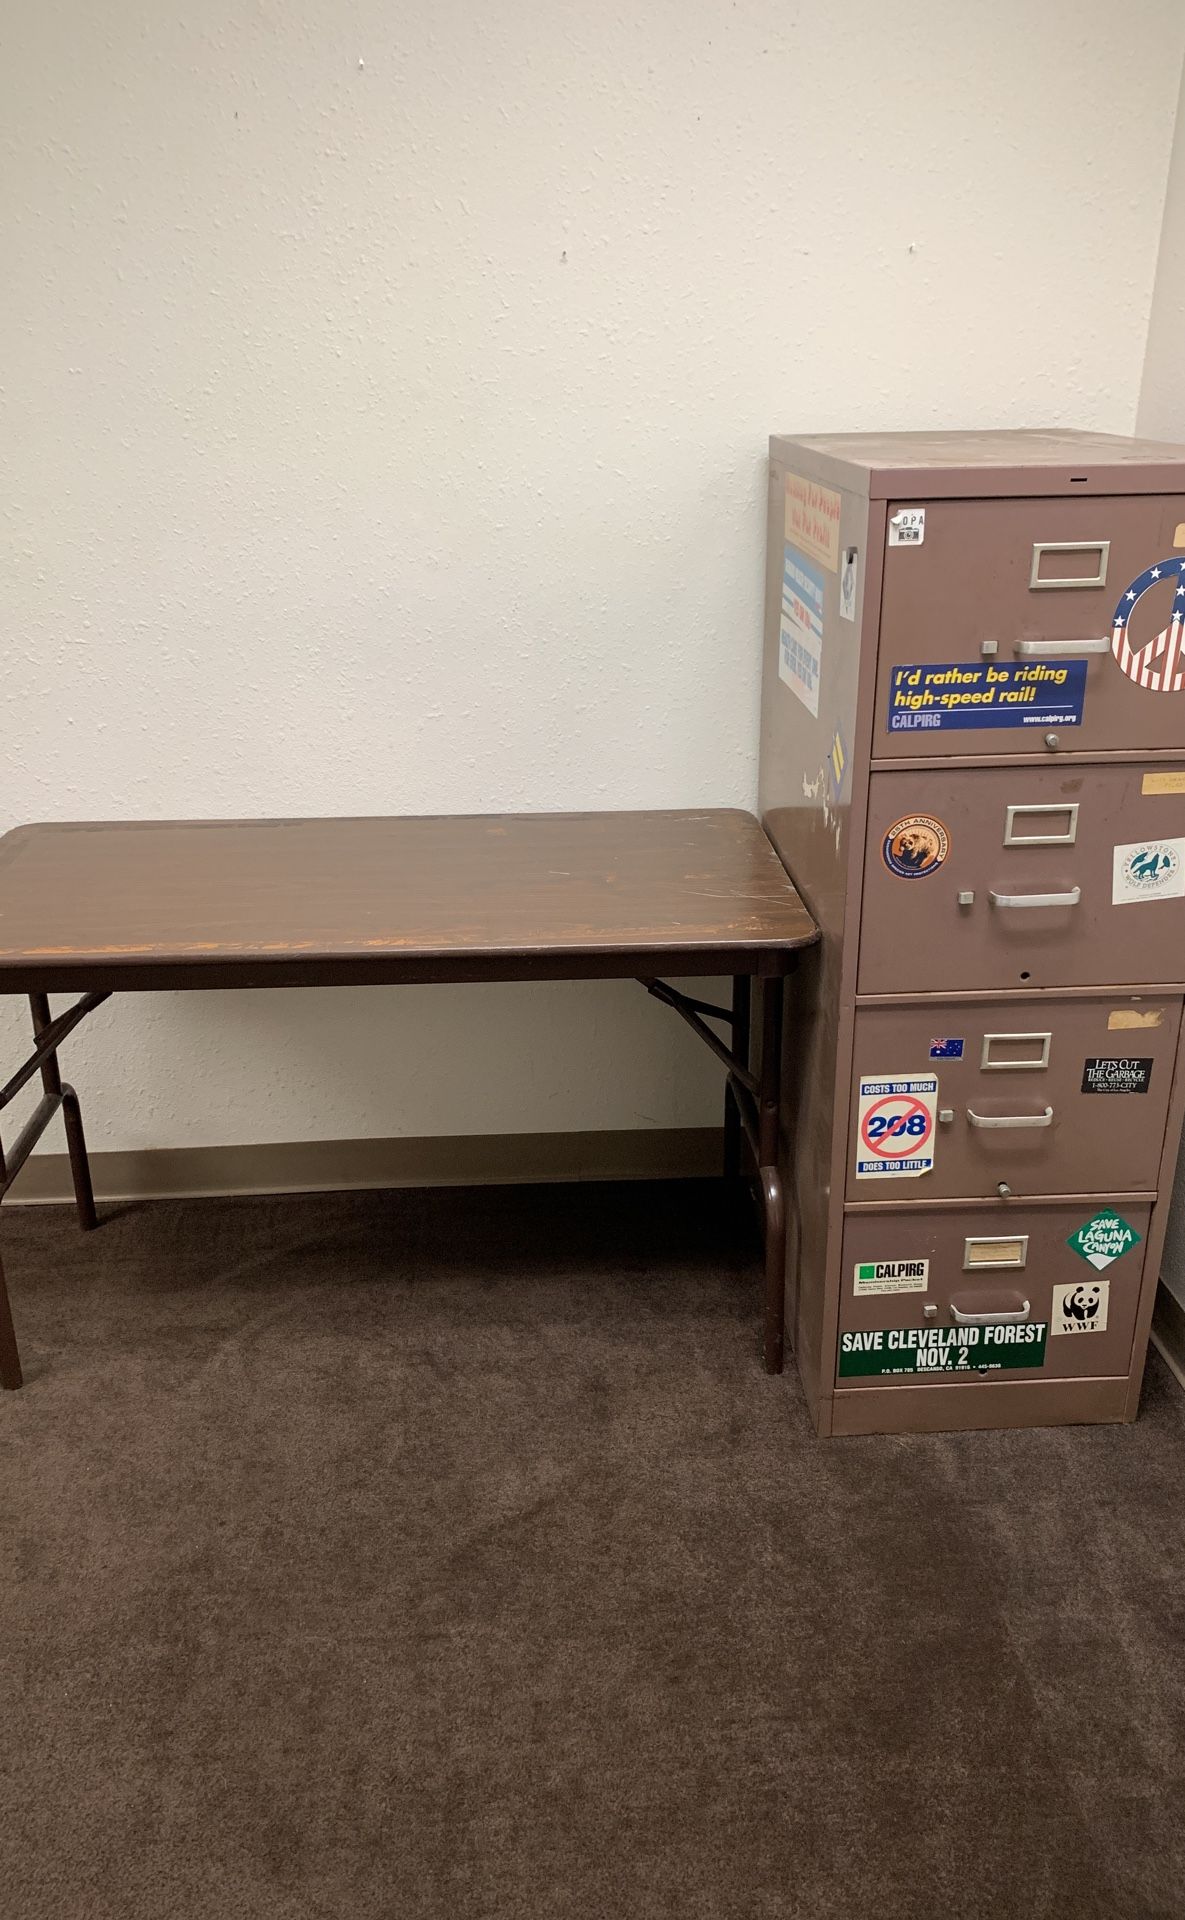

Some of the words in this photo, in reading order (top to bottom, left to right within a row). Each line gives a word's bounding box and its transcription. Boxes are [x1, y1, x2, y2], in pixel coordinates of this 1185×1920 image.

[895, 669, 922, 686] I'd
[924, 667, 982, 685] rather
[985, 666, 1009, 683] be
[1013, 665, 1068, 685] riding
[893, 687, 996, 709] high-speed
[998, 685, 1037, 702] rail!
[892, 713, 941, 729] CALPIRG
[1023, 714, 1077, 724] www.calpirg.org
[890, 820, 911, 837] 25TH
[913, 818, 947, 859] ANNIVERSARY
[1119, 1059, 1140, 1070] CUT
[1087, 1069, 1104, 1079] THE
[1105, 1069, 1146, 1079] GARBAGE
[864, 1083, 890, 1094] COSTS
[892, 1083, 908, 1093] TOO
[909, 1082, 934, 1092] MUCH
[868, 1114, 926, 1138] 208
[862, 1162, 884, 1172] DOES
[885, 1161, 901, 1171] TOO
[902, 1160, 928, 1170] LITTLE
[1089, 1218, 1120, 1231] SAVE
[1078, 1229, 1132, 1243] LAGUNA
[1082, 1241, 1125, 1254] CANYON
[876, 1262, 925, 1279] CALPIRG
[1062, 1321, 1099, 1332] WWF
[842, 1331, 884, 1352] SAVE
[887, 1327, 980, 1350] CLEVELAND
[983, 1323, 1046, 1345] FOREST
[916, 1348, 953, 1367] NOV.
[957, 1347, 969, 1365] 2
